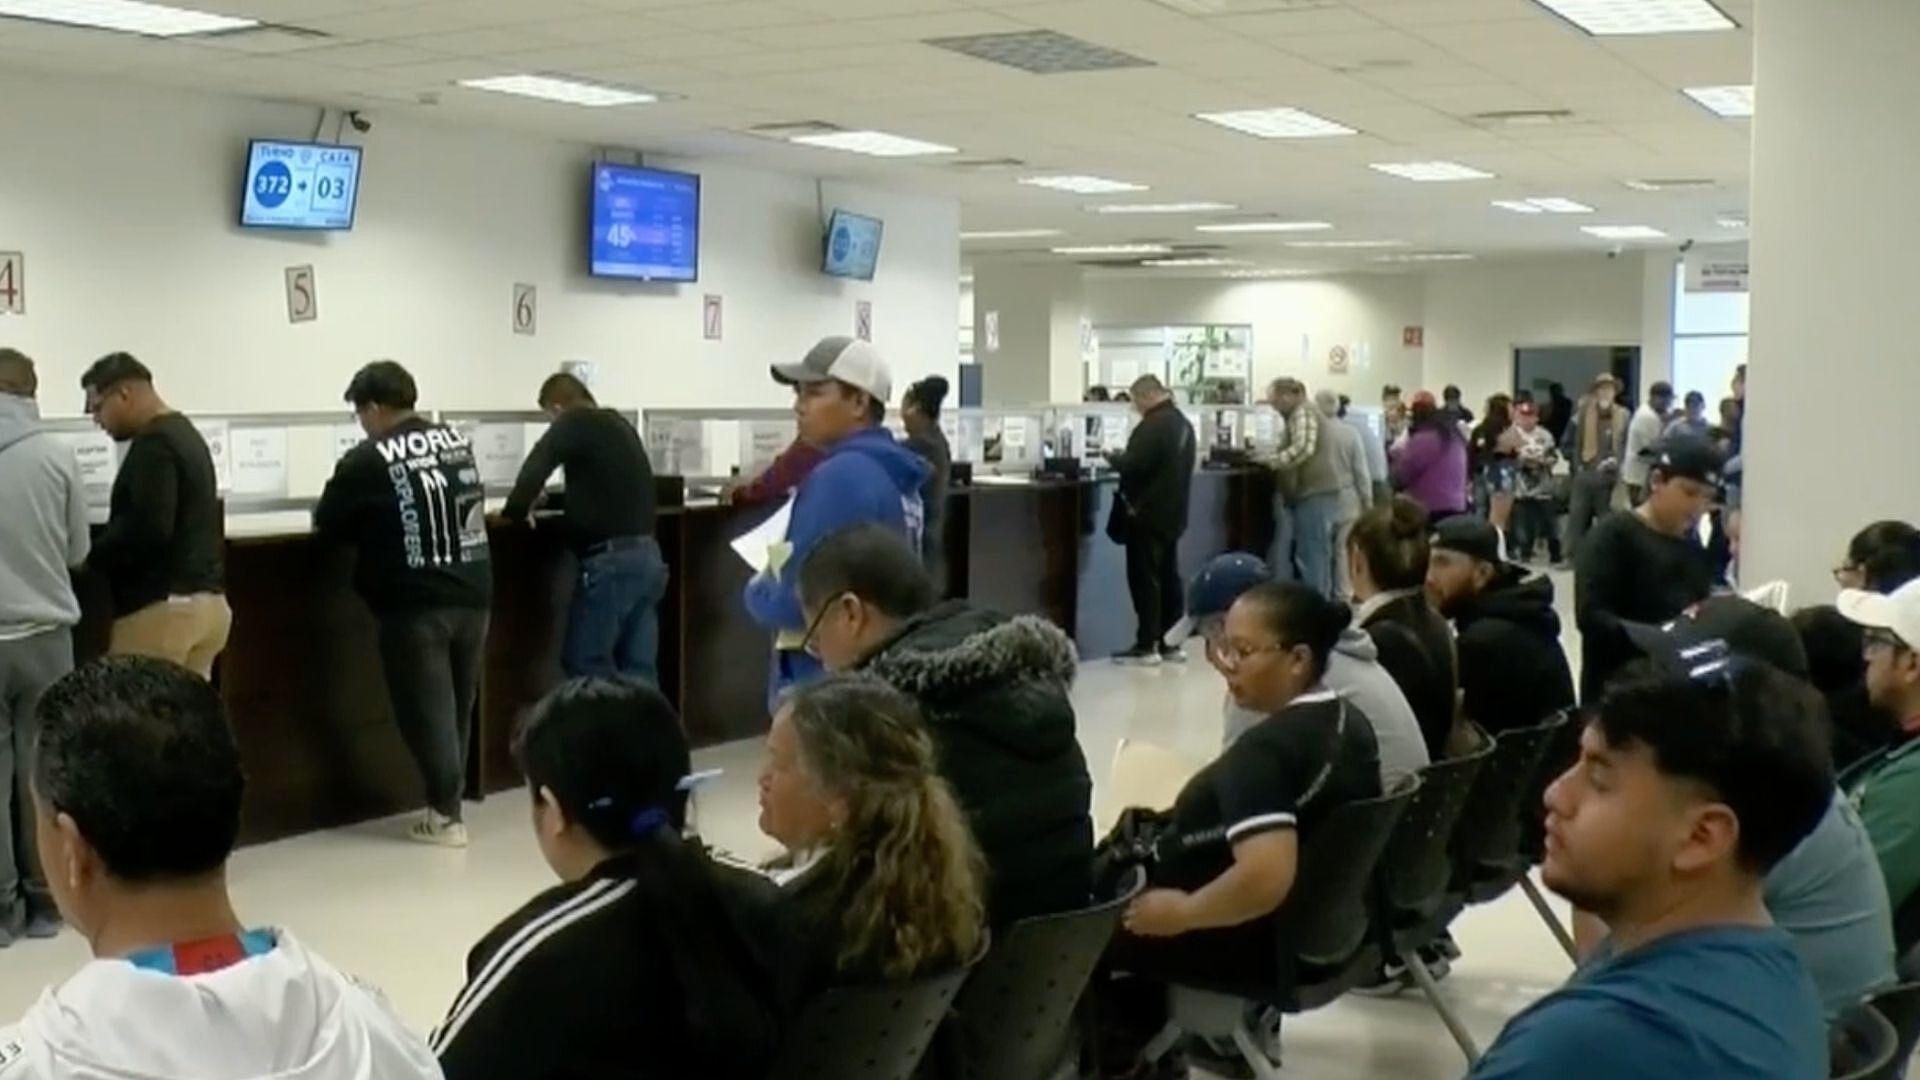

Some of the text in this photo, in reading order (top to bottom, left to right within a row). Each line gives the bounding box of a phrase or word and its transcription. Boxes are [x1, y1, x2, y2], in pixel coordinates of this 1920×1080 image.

[256, 174, 289, 195] 372
[317, 175, 344, 199] 03
[0, 259, 18, 307] 4
[295, 273, 310, 315] 5
[517, 291, 532, 327] 6
[708, 300, 720, 334] 7
